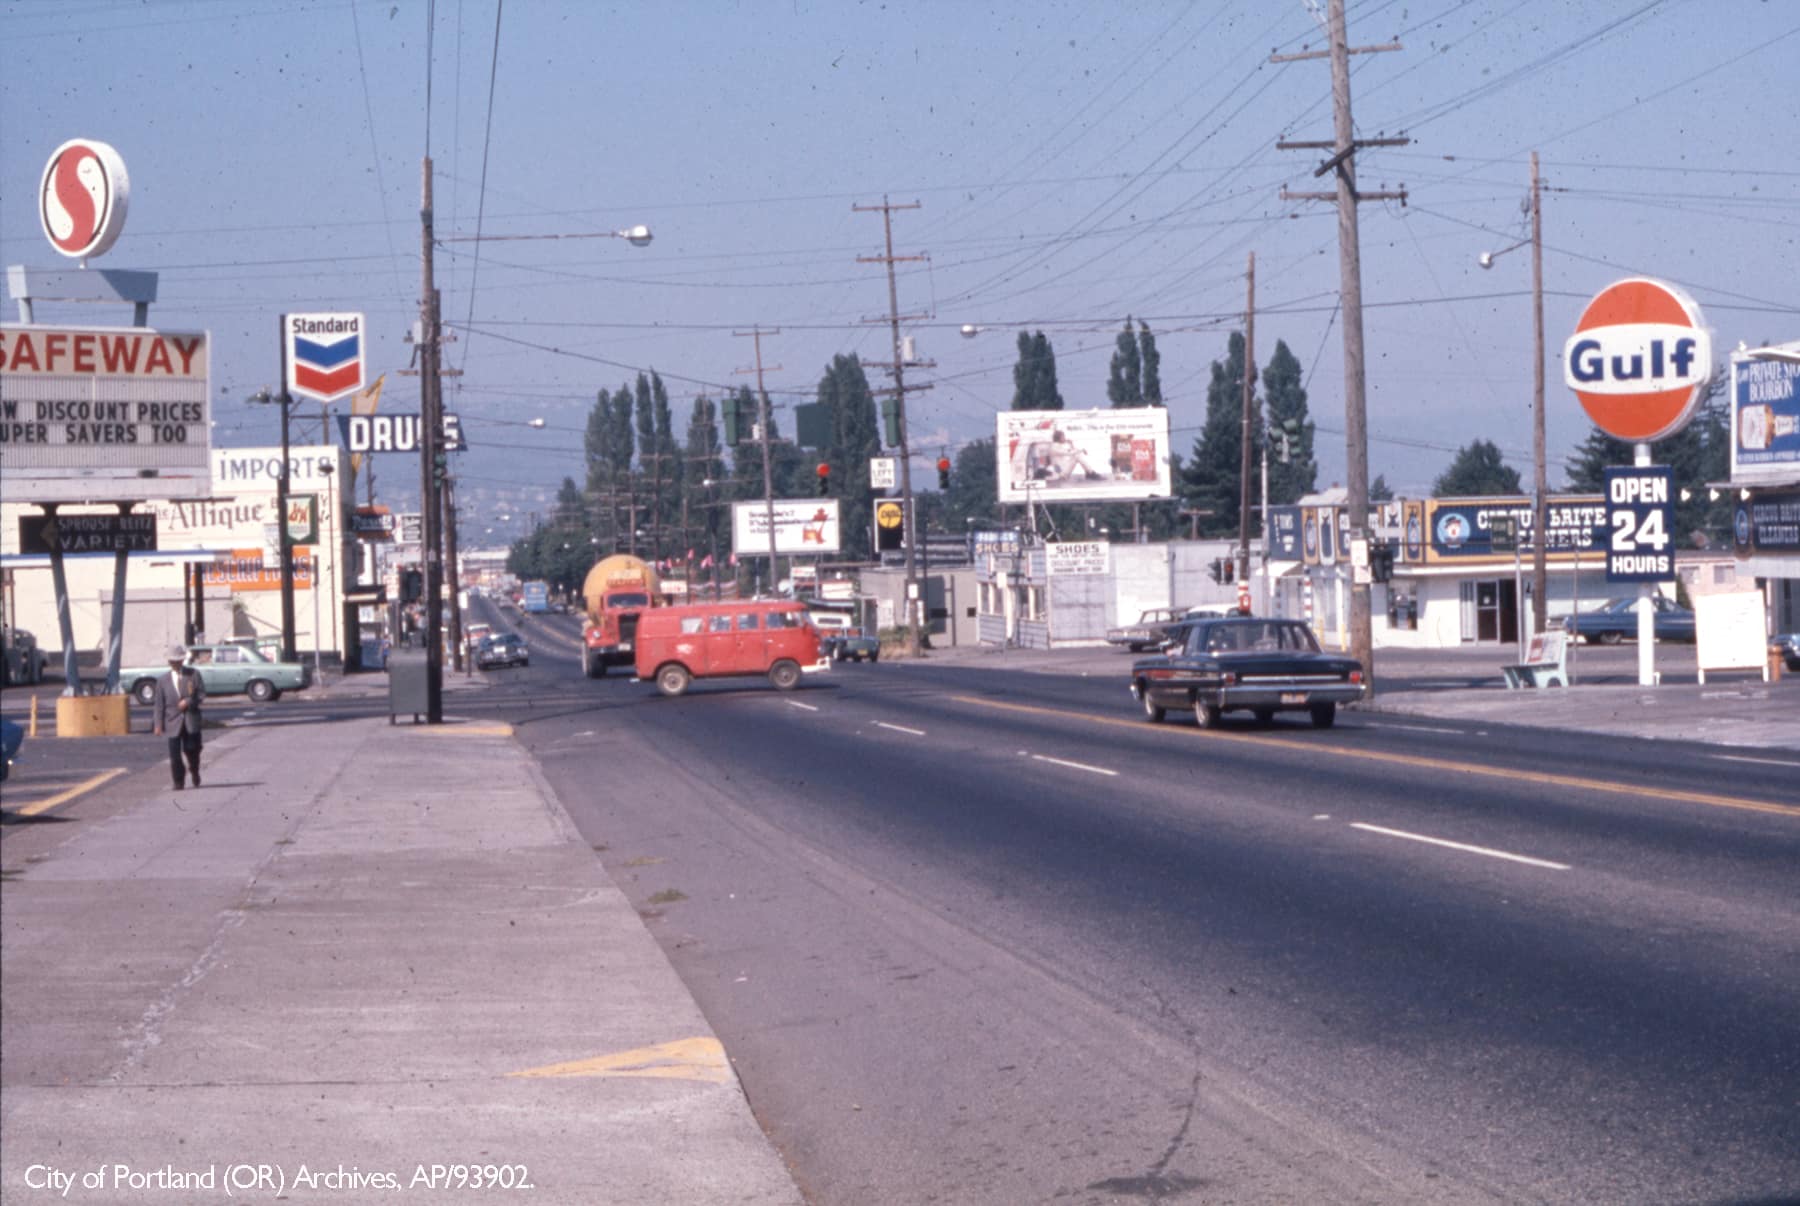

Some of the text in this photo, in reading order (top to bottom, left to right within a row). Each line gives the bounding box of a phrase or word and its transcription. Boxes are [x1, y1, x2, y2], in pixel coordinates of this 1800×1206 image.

[292, 317, 359, 333] Standard
[0, 333, 201, 375] AFEWAY
[1569, 337, 1696, 382] Gulf
[1749, 380, 1794, 402] BOURBON
[36, 402, 129, 421] DISCOUNT
[138, 402, 202, 421] PRICES
[0, 424, 187, 443] UPER SAVERS TOO
[350, 415, 459, 451] DRUS
[220, 456, 332, 480] IMPORTS
[873, 469, 892, 477] LEFT
[1611, 476, 1668, 503] OPEN
[1612, 510, 1669, 550] 24
[59, 534, 153, 549] VARIETY
[1055, 544, 1100, 554] SHOES
[1611, 555, 1669, 574] HOURS
